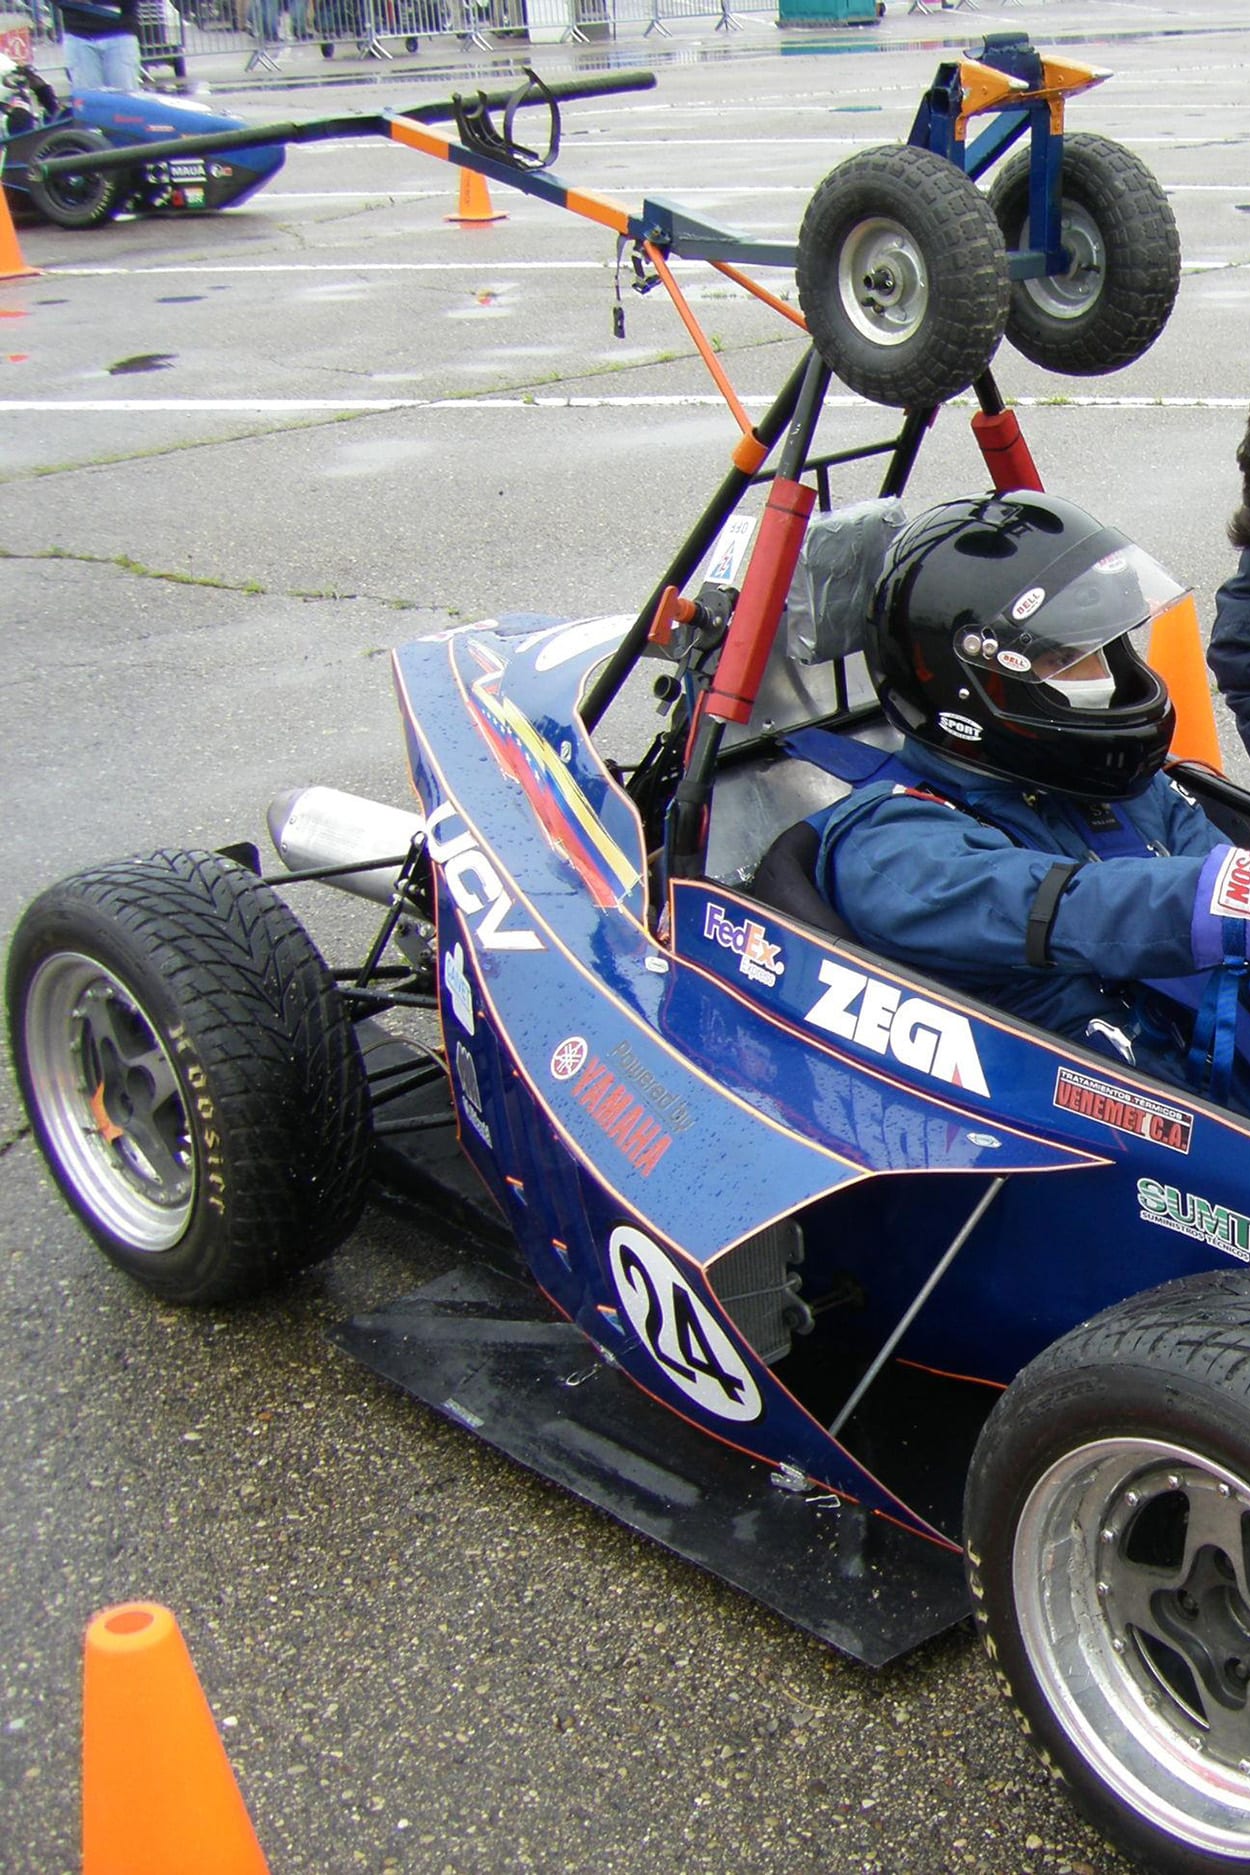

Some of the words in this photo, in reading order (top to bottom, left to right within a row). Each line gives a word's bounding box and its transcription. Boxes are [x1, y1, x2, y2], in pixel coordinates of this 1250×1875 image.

[1016, 593, 1041, 615] BELL
[1003, 655, 1026, 667] BELL
[939, 716, 982, 738] SPORT
[426, 801, 548, 950] UCV
[804, 959, 991, 1098] ZEGA
[570, 1056, 673, 1178] YAMAHA
[610, 1040, 681, 1110] Powered
[670, 1101, 696, 1132] by
[1057, 1081, 1147, 1135] VENEMET
[1149, 1114, 1188, 1150] C.A.
[1060, 1071, 1131, 1102] TRATAMIENTOS
[1141, 1211, 1204, 1241] SUMINISTROS
[619, 1244, 745, 1405] 24
